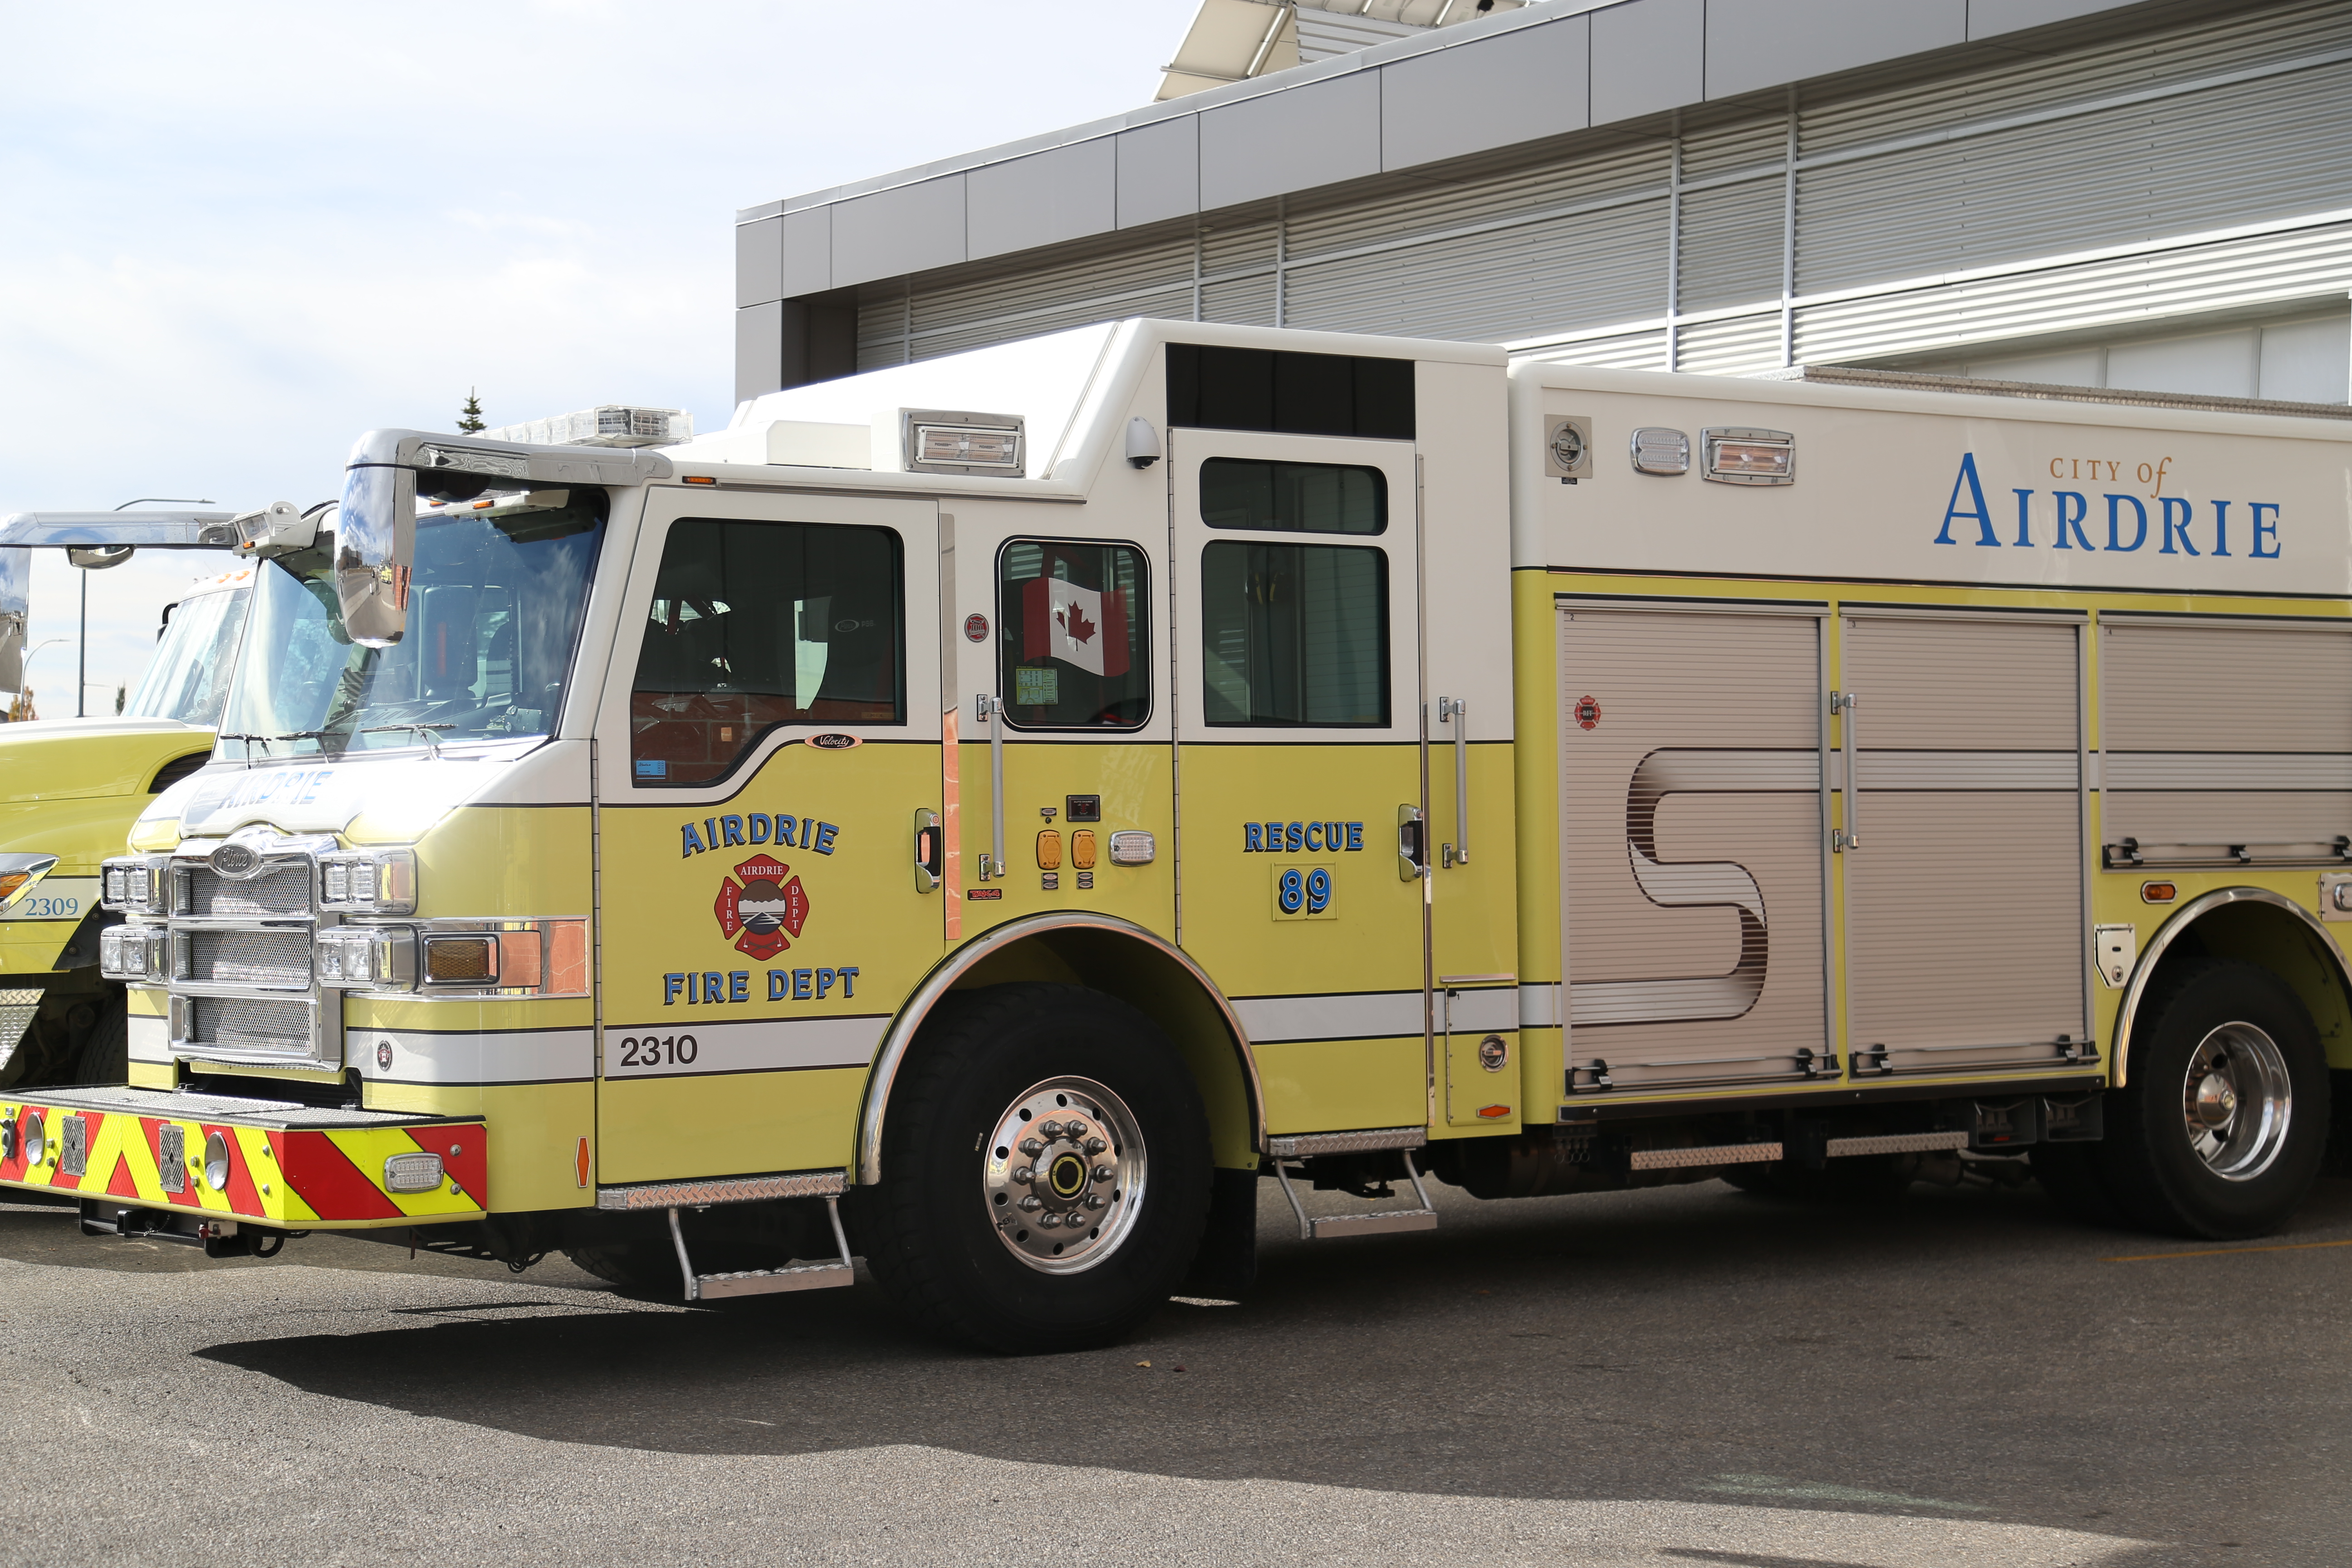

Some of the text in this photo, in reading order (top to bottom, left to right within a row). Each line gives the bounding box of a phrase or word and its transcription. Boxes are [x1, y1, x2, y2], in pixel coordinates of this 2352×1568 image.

[2049, 456, 2172, 498] CITY of
[1933, 451, 2282, 559] AIRDRIE
[819, 735, 850, 747] Velocity
[216, 770, 335, 809] AIRDRIE
[681, 813, 839, 859] AIRDRIE
[1243, 821, 1364, 853] RESCUE
[220, 848, 249, 870] Pierce
[740, 866, 784, 876] AIRDRIE
[24, 897, 78, 916] 2309
[791, 886, 799, 929] DEPT
[1278, 867, 1332, 916] 89
[663, 966, 859, 1006] FIRE DEPT
[620, 1034, 698, 1067] 2310
